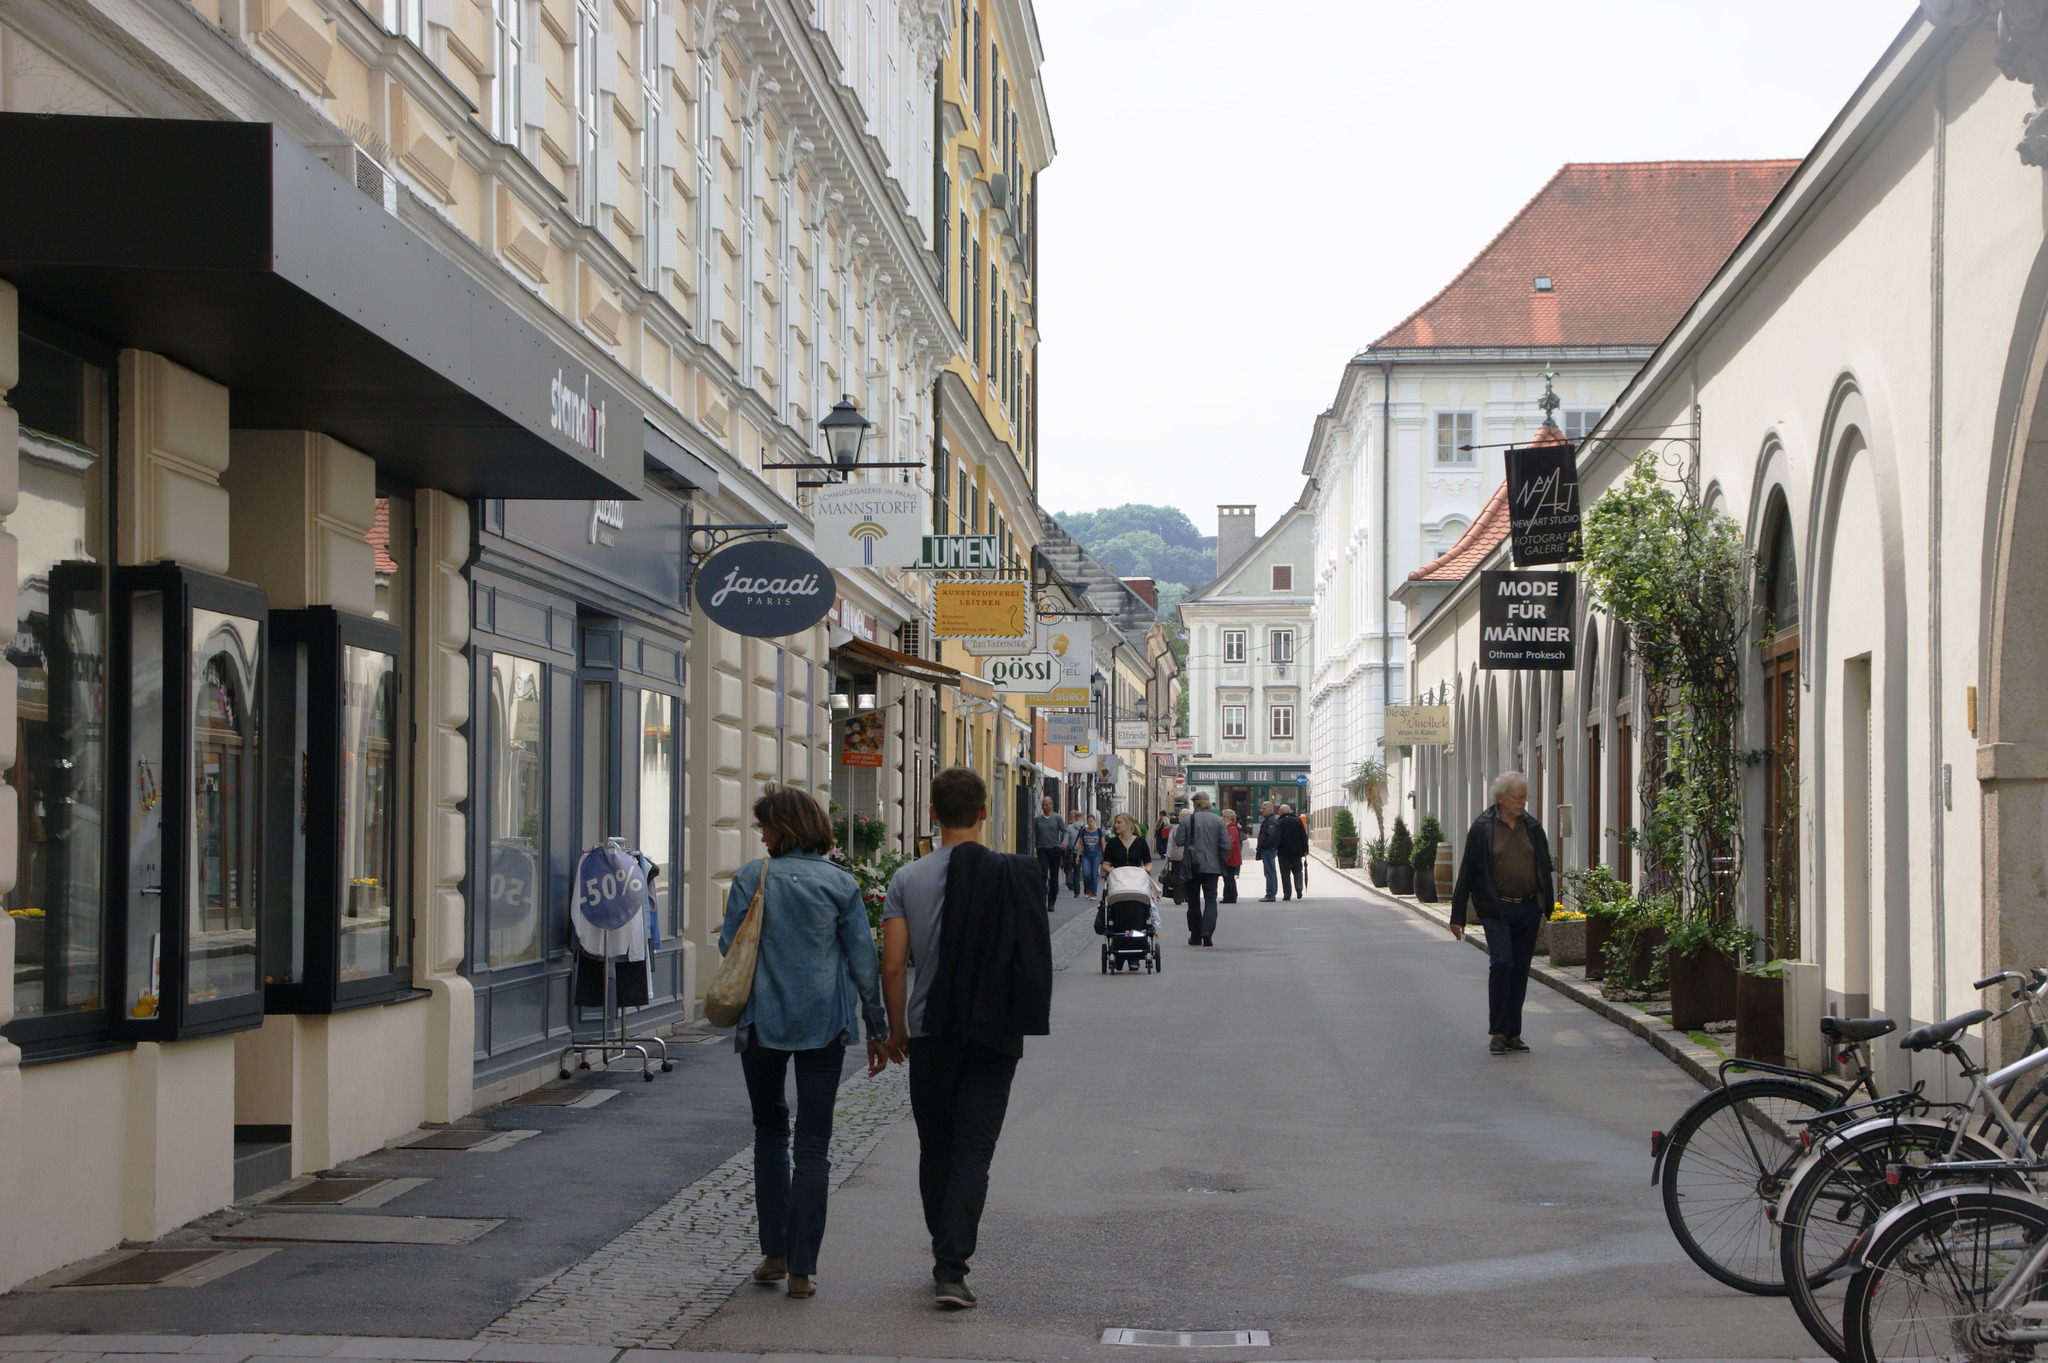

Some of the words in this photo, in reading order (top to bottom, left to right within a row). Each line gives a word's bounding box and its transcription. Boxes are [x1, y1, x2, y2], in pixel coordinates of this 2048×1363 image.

[818, 487, 882, 503] SCHMUCKGALERIE
[895, 489, 918, 501] PALAIS
[818, 501, 918, 515] MANNSTORFF
[1512, 519, 1532, 529] NEW
[1532, 518, 1548, 527] ART
[1550, 514, 1579, 526] STUDIO
[1514, 531, 1576, 546] FOTOGRAFI
[917, 537, 996, 568] LUMEN
[1524, 543, 1566, 556] GALERIE
[711, 565, 820, 607] jacadi
[942, 589, 1021, 597] KUNSTSTOPFEREI
[1497, 581, 1559, 597] MODE
[747, 596, 792, 606] PARIS
[1507, 599, 1547, 619] FÜR
[1483, 622, 1570, 642] MÄNNER
[1488, 650, 1524, 660] Othmar
[1525, 650, 1566, 660] Prokesch
[991, 656, 1052, 686] gössl
[1052, 733, 1078, 741] Studio
[1118, 731, 1148, 740] Elfriede
[1253, 771, 1268, 781] UTZ
